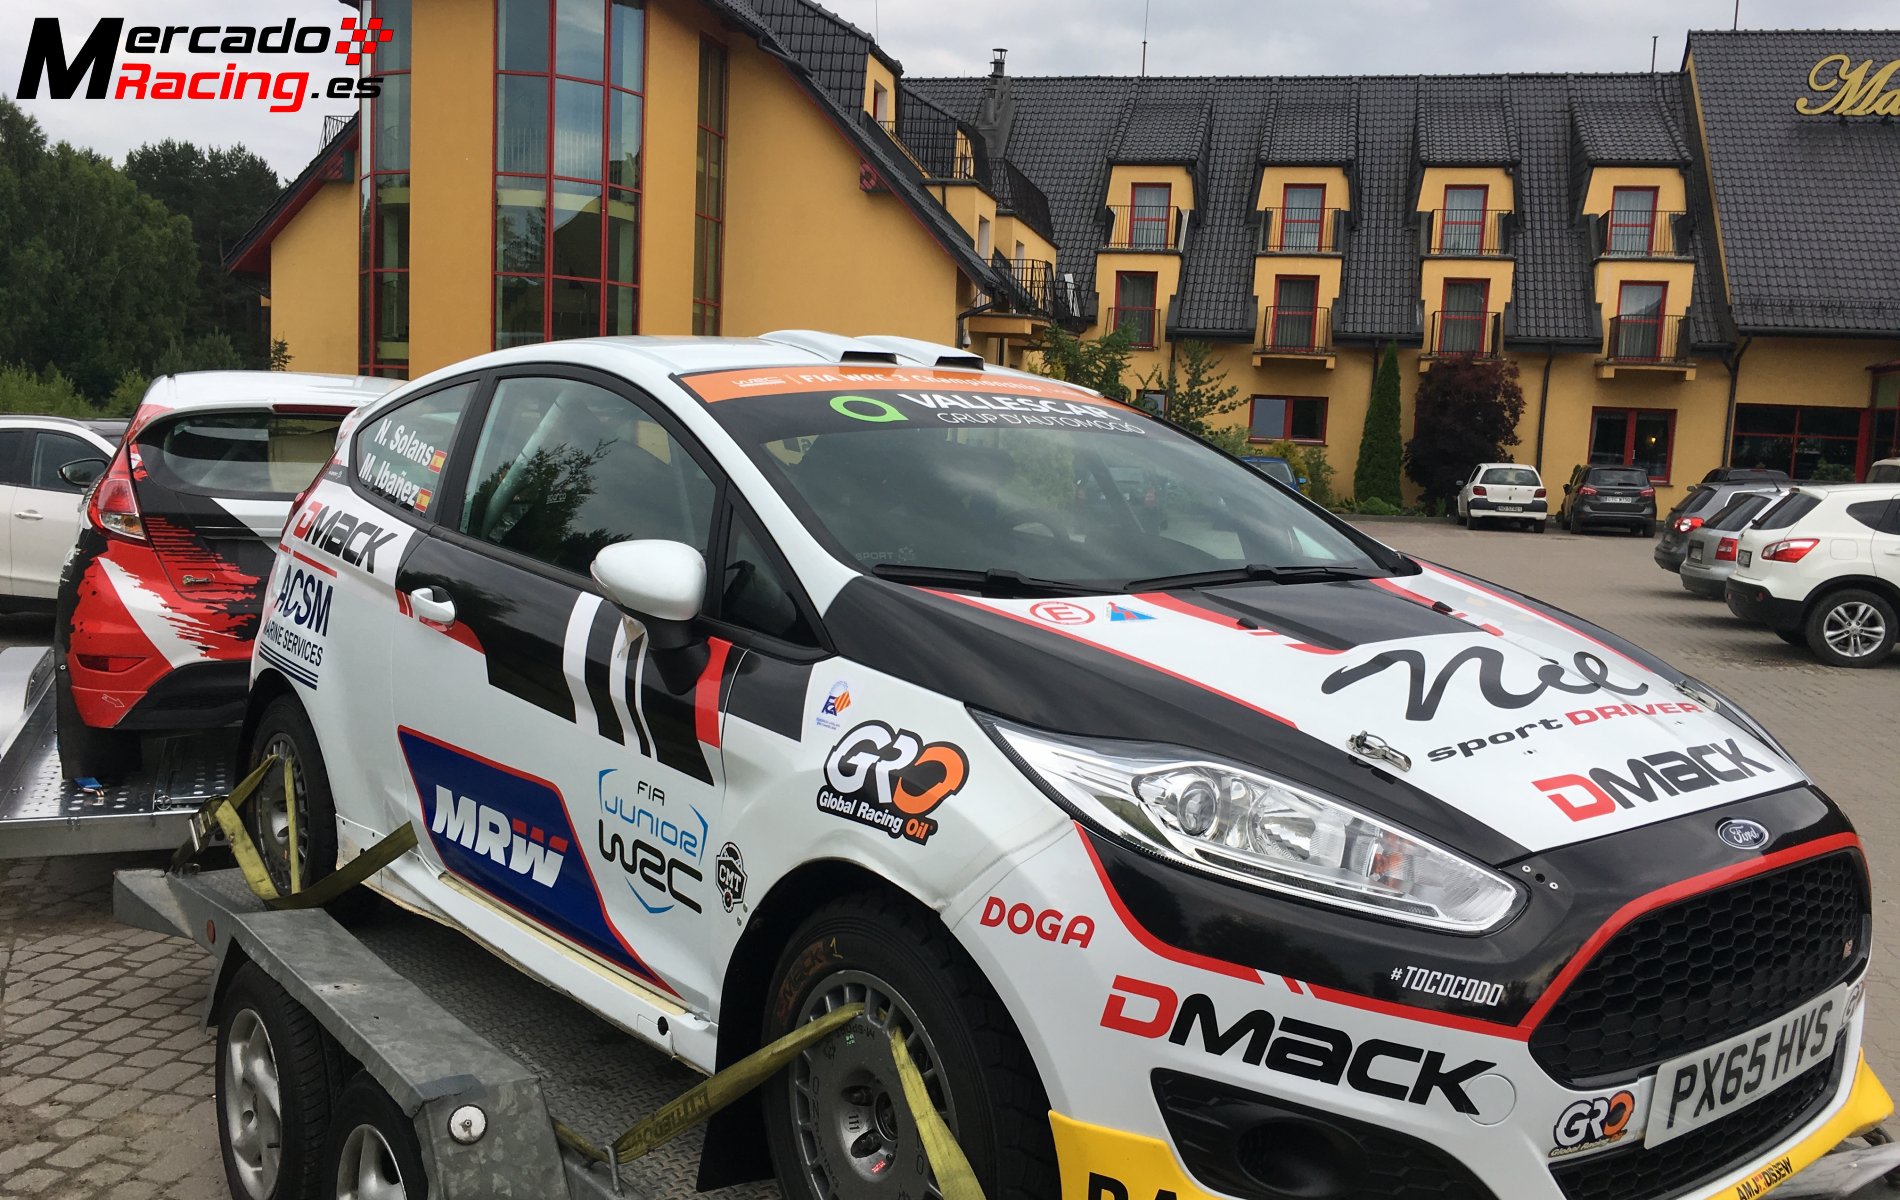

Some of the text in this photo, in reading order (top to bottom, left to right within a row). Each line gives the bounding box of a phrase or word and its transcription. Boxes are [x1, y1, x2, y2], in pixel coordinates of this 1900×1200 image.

[799, 374, 842, 384] FIA
[842, 374, 893, 383] WRC
[898, 393, 1122, 421] VALLESCAR
[936, 412, 998, 424] GRUP
[358, 452, 377, 482] M.
[374, 418, 435, 467] N. Solans
[273, 563, 334, 638] ACSM
[282, 628, 324, 668] SERVICES
[1426, 701, 1704, 762] sport DRIVER
[636, 779, 666, 807] FIA
[825, 721, 967, 816] GRO
[431, 784, 569, 889] MRW
[819, 790, 930, 840] Global Racing Oil
[1728, 825, 1760, 844] Ford
[598, 818, 703, 915] WRC
[717, 863, 743, 893] CMT
[979, 895, 1096, 949] DOGA
[1666, 1031, 1773, 1130] PX65
[1771, 1000, 1834, 1082] HVS
[1553, 1090, 1635, 1147] GRO
